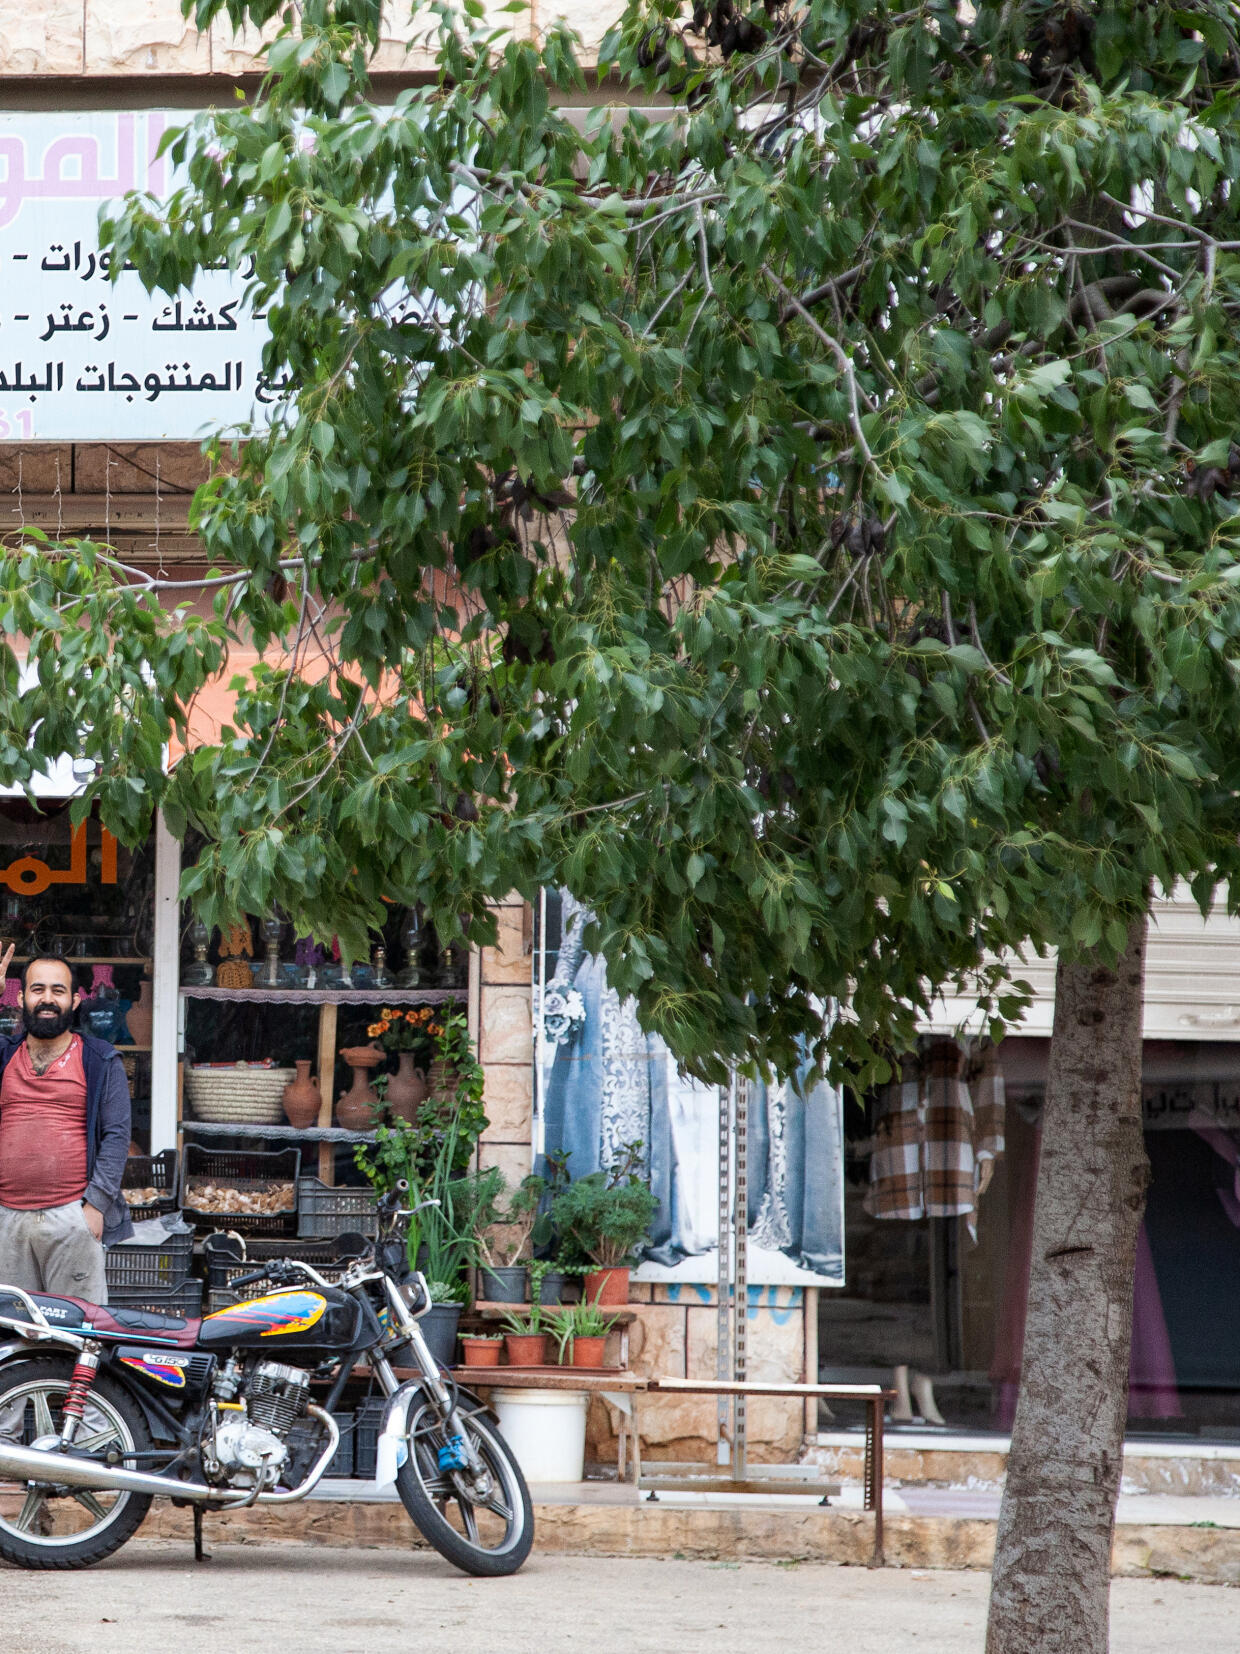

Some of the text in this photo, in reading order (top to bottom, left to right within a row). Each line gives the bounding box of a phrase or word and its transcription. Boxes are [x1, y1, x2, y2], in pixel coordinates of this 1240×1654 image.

[39, 302, 110, 341] زعتر
[152, 299, 238, 331] كشك
[76, 360, 242, 403] المنتوجات
